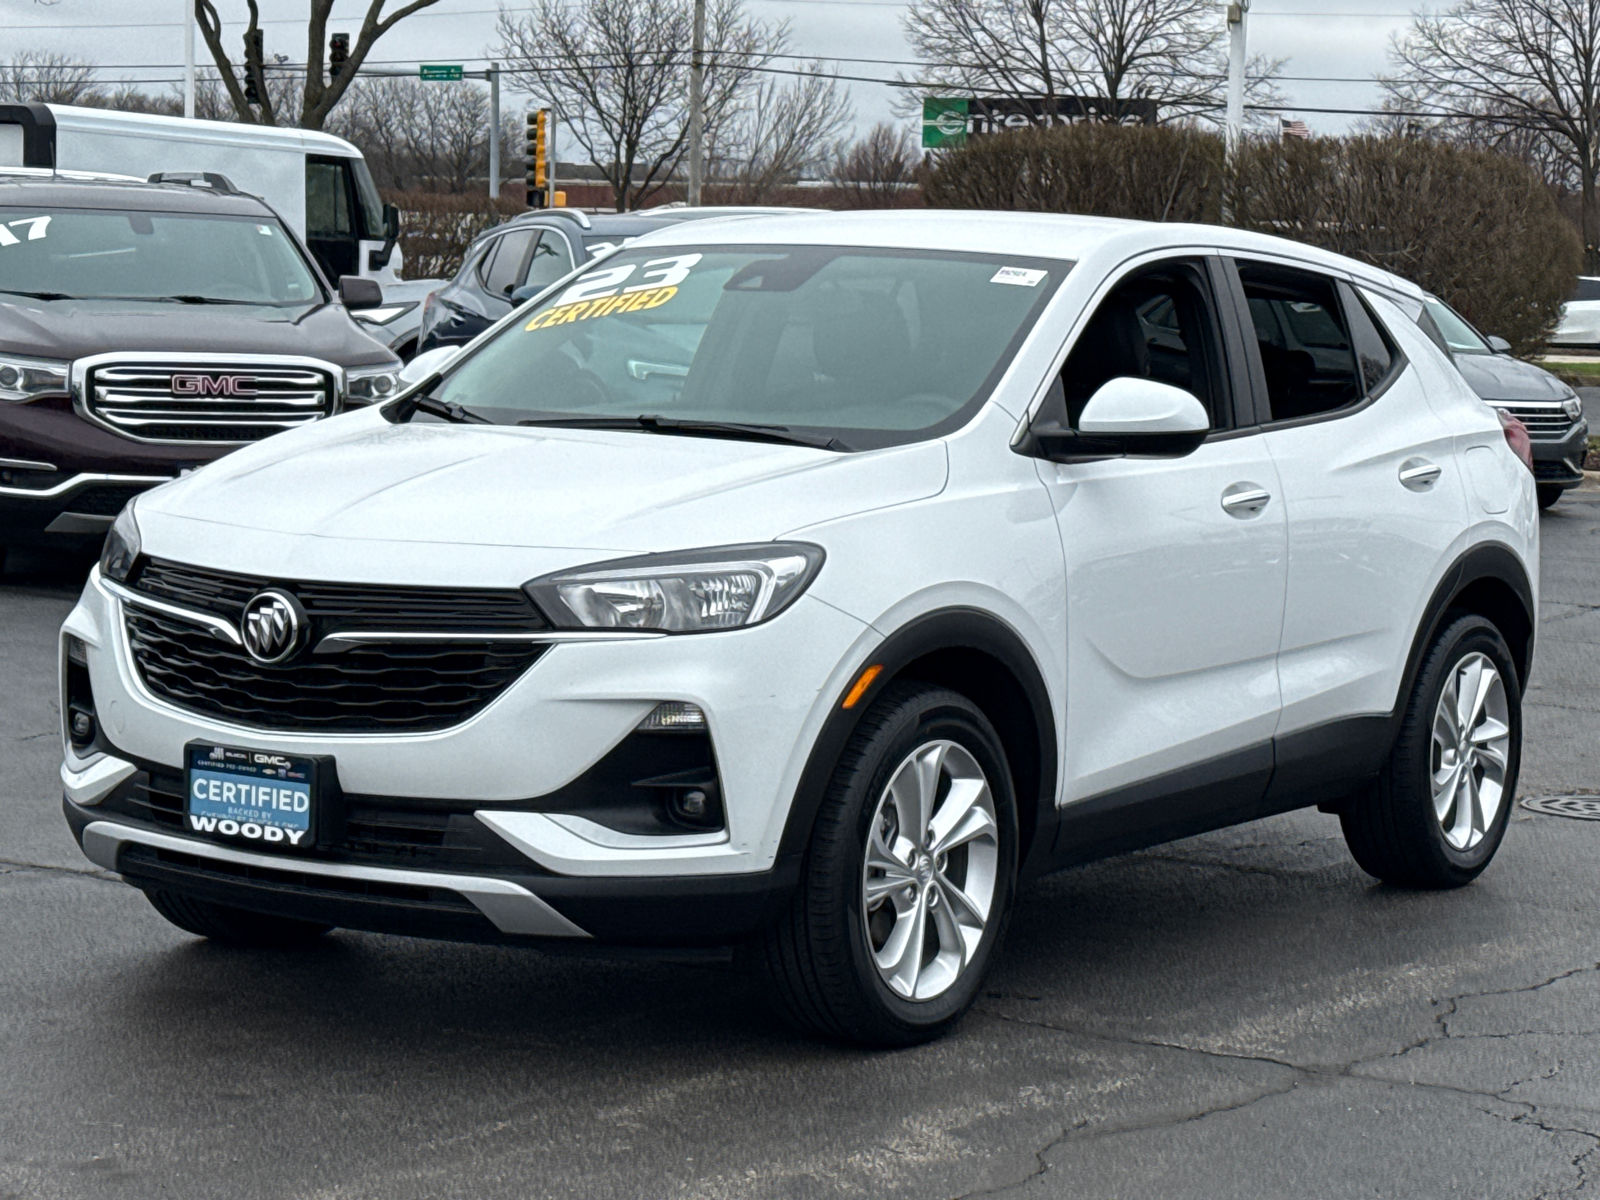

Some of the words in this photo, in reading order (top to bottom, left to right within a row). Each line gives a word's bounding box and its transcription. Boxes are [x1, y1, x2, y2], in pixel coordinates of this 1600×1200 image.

[553, 253, 703, 307] 23
[525, 286, 678, 332] CERTIFIED
[172, 374, 258, 395] GMC
[254, 754, 285, 766] GMC
[193, 778, 309, 813] CERTIFIED
[228, 806, 259, 818] BACKED
[261, 811, 272, 819] BY
[190, 815, 305, 845] WOODY
